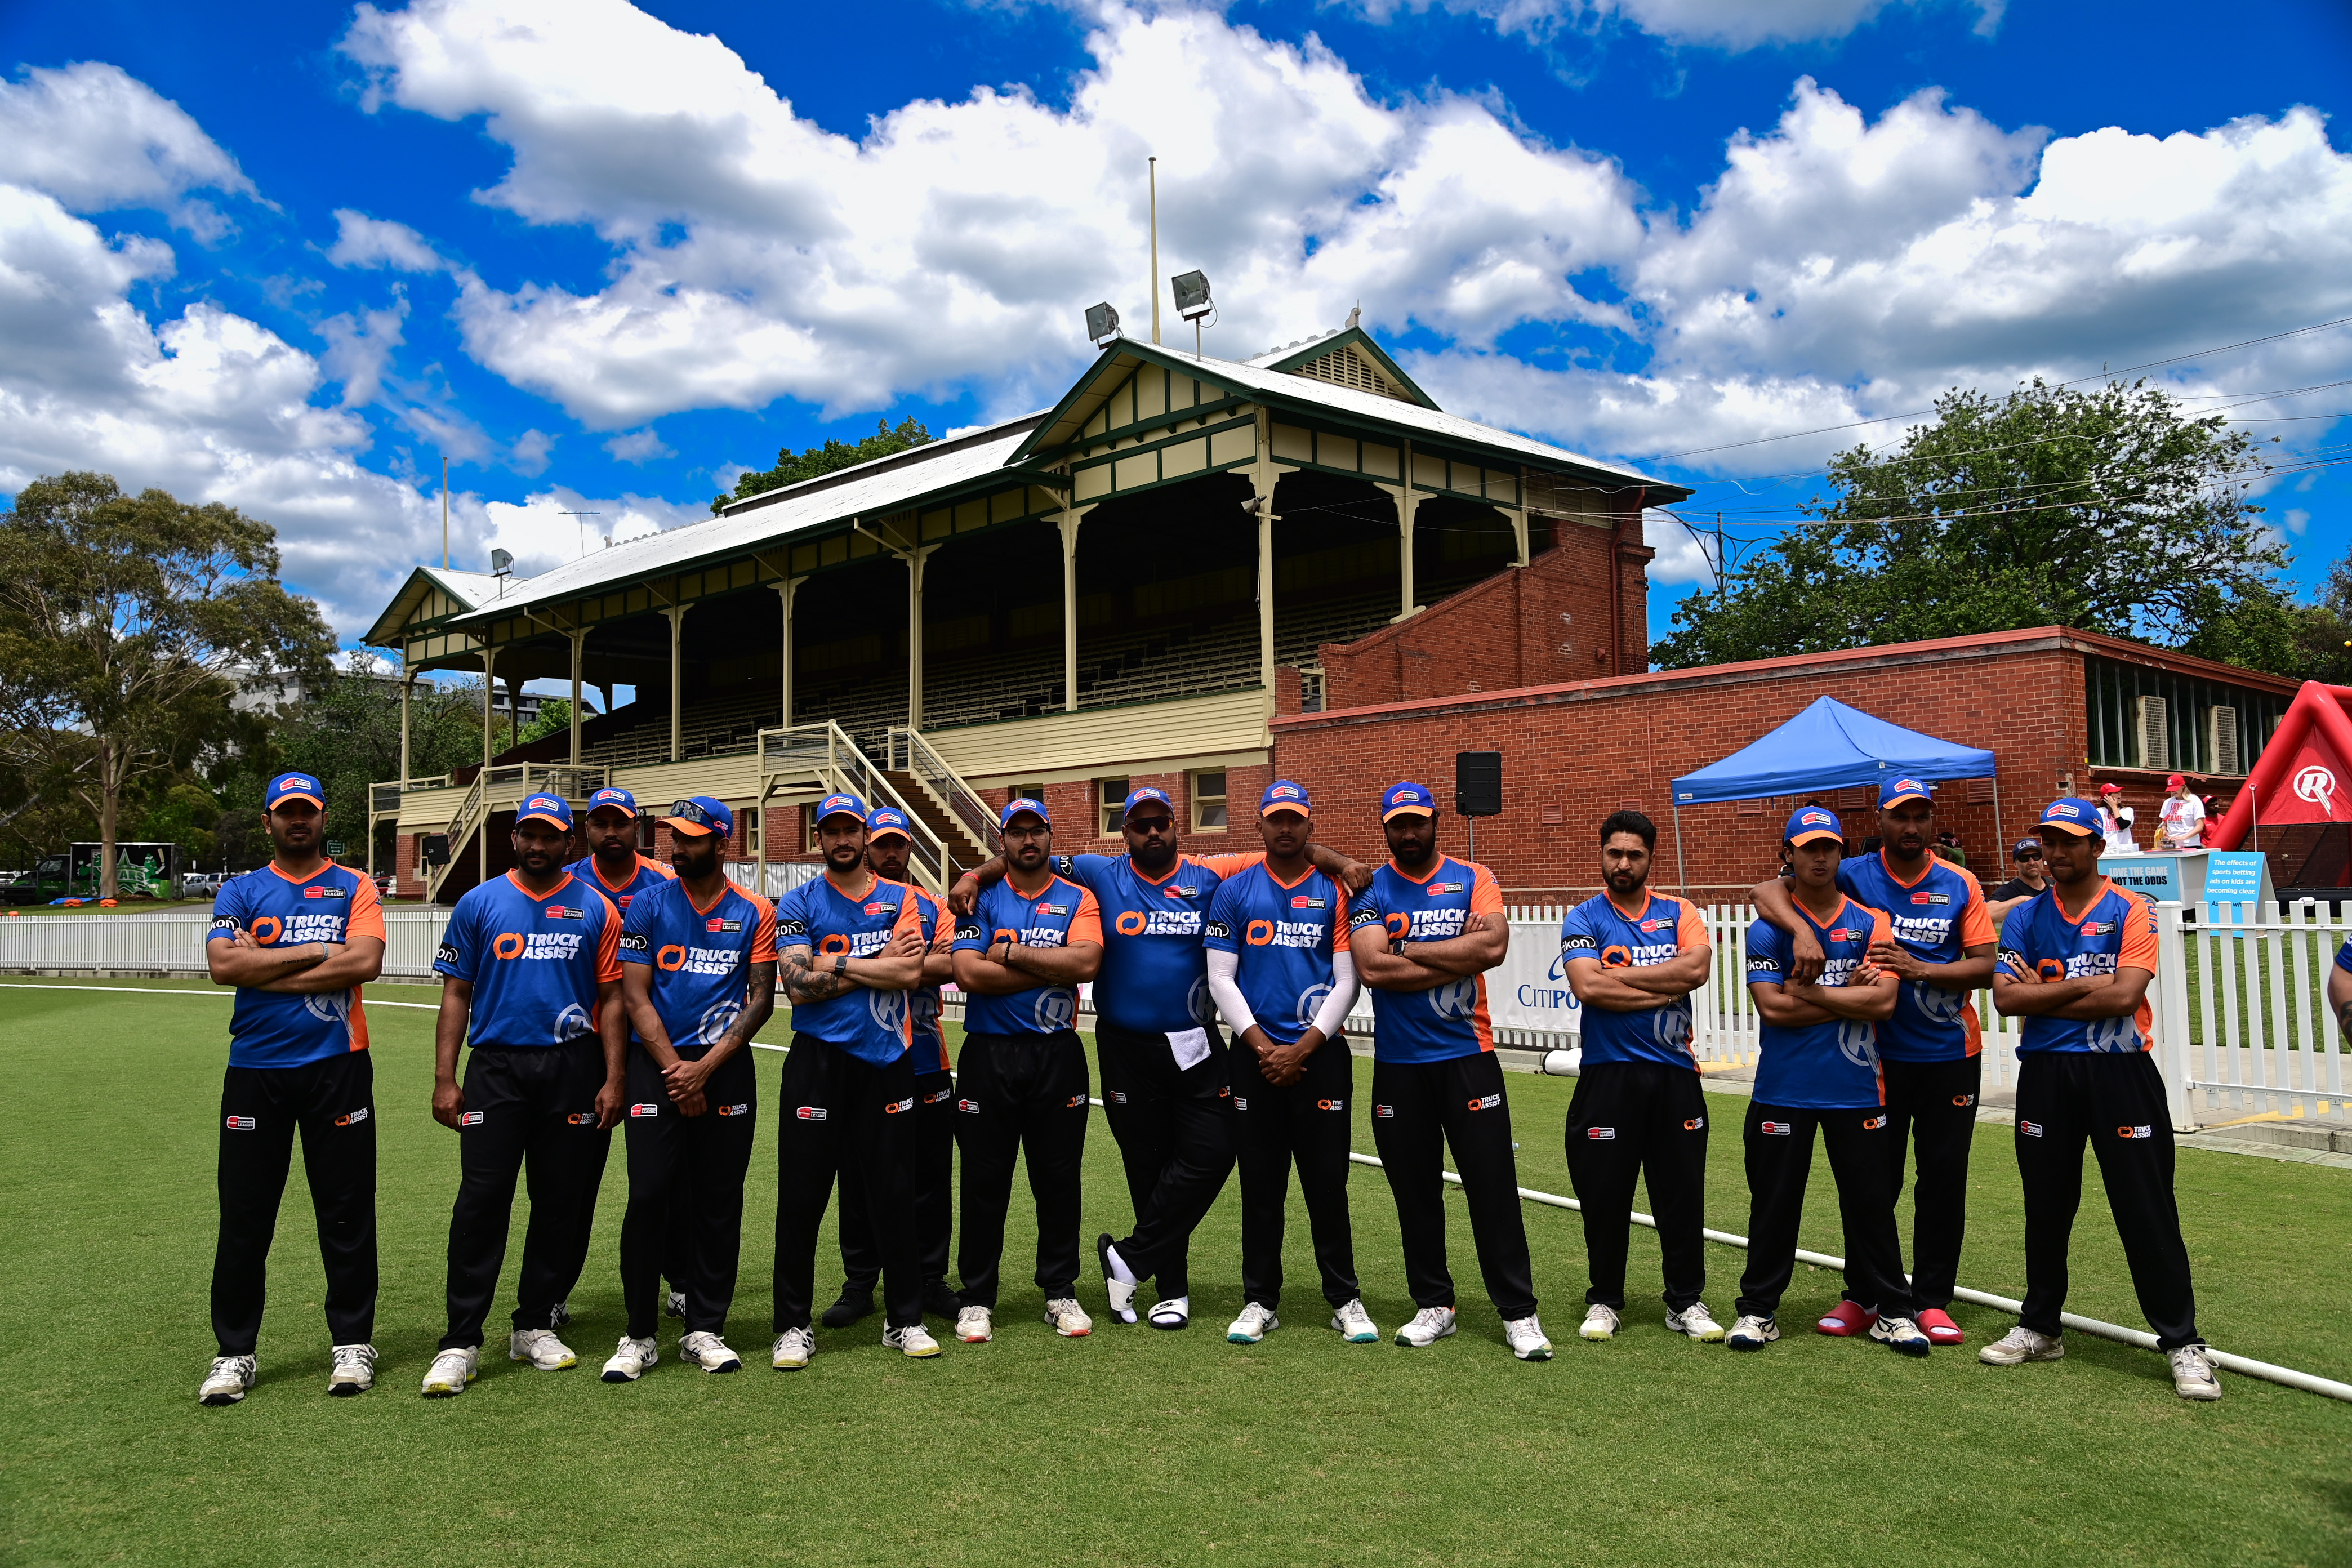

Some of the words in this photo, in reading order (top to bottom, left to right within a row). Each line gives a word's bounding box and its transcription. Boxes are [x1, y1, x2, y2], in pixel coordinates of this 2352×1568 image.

[2109, 867, 2128, 876] LOVE
[2129, 867, 2143, 876] THE
[2145, 866, 2168, 875] GAME
[2112, 877, 2127, 886] NOT
[2128, 876, 2143, 885] THE
[2145, 876, 2167, 885] ODDS
[285, 915, 345, 929] TRUCK
[1149, 911, 1201, 923] TRUCK
[1412, 908, 1466, 924] TRUCK
[1894, 914, 1953, 932] TRUCK
[210, 919, 235, 932] kon
[1143, 923, 1201, 935] ASSIST
[1276, 920, 1325, 936] TRUCK
[1408, 923, 1464, 938] ASSIST
[279, 928, 340, 943] ASSIST
[527, 933, 582, 947] TRUCK
[852, 929, 893, 945] TRUC
[953, 929, 973, 942] kon
[1271, 933, 1321, 948] ASSIST
[1891, 926, 1949, 944] ASSIST
[436, 948, 452, 962] on
[521, 946, 578, 960] ASSIST
[689, 947, 741, 963] TRUCK
[848, 943, 888, 957] ASS
[1632, 943, 1677, 959] TRUCK
[1632, 957, 1673, 967] ASSIS
[1824, 959, 1859, 973] RUC
[2066, 953, 2115, 967] TRUCK
[681, 960, 738, 976] ASSIST
[1518, 984, 1580, 1010] CITIPO
[1481, 1093, 1500, 1103] TRUCK
[1481, 1099, 1501, 1110] ASSIST
[349, 1112, 368, 1124] ASSIST
[350, 1107, 368, 1119] TRUCK
